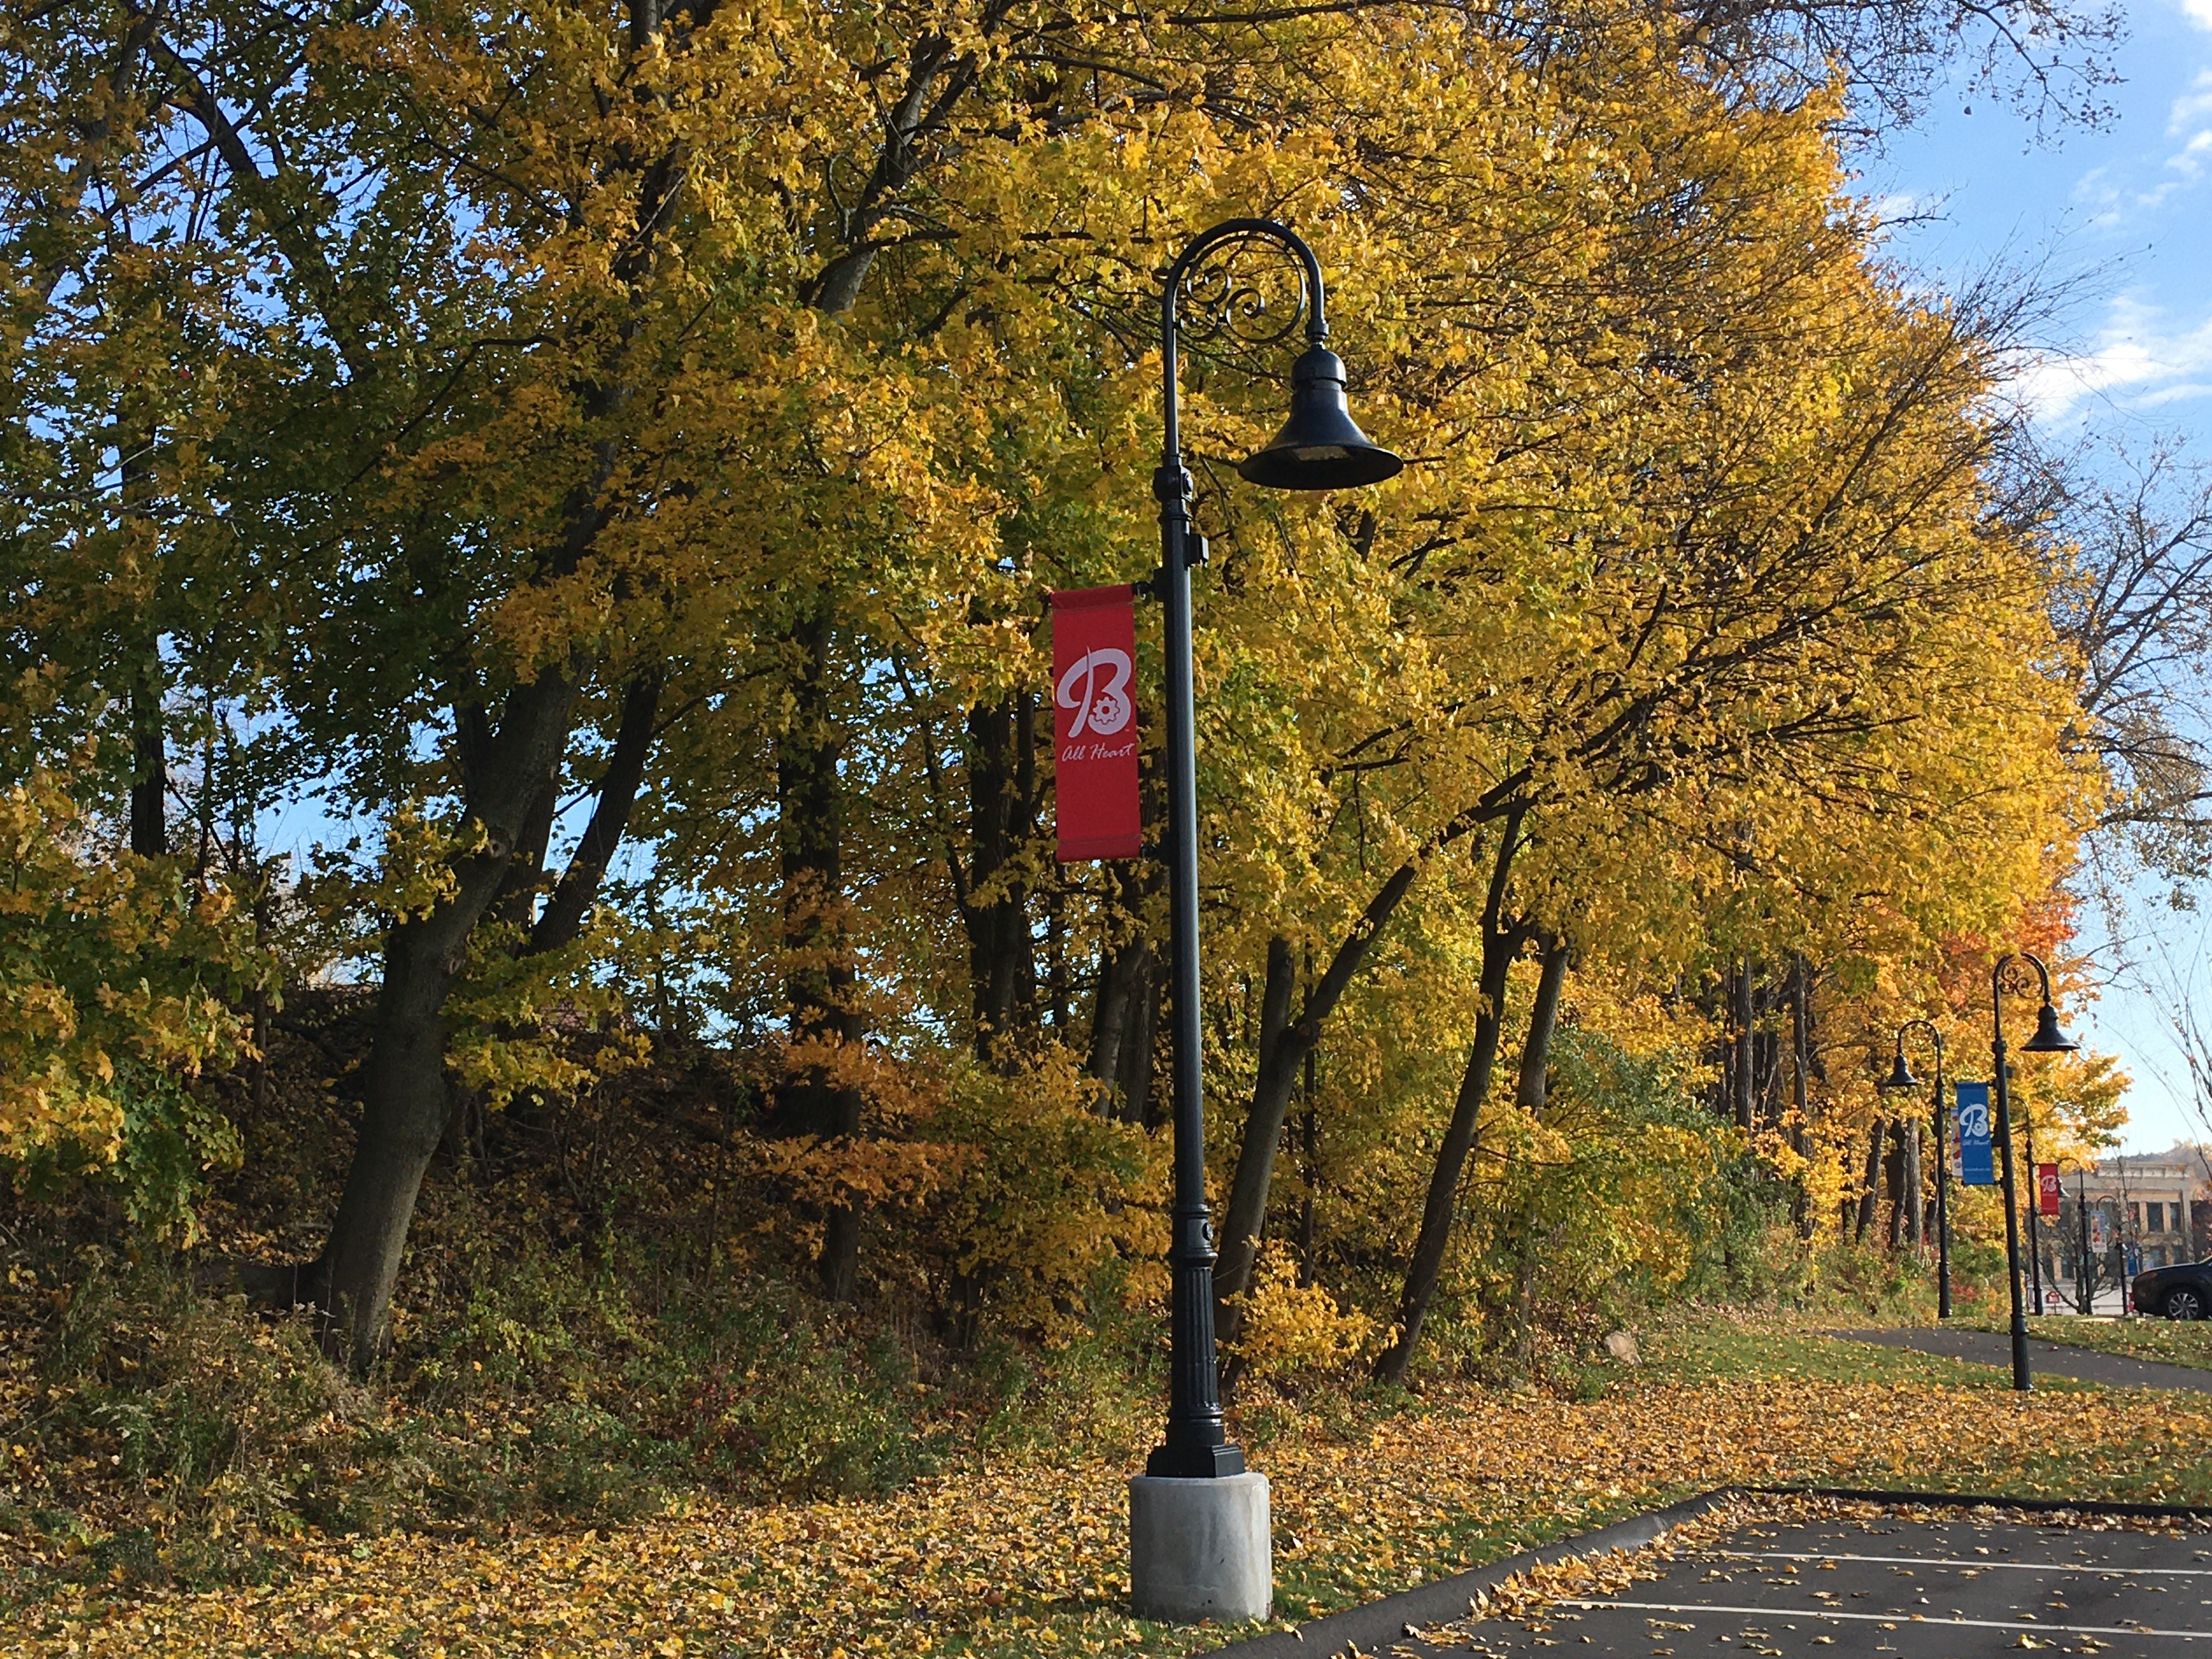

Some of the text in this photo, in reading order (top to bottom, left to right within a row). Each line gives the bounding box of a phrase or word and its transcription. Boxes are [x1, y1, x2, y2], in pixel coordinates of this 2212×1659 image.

[1057, 645, 1132, 738] B
[1062, 742, 1135, 762] All Heart
[1959, 1103, 1988, 1137] B
[2040, 1175, 2057, 1193] B
